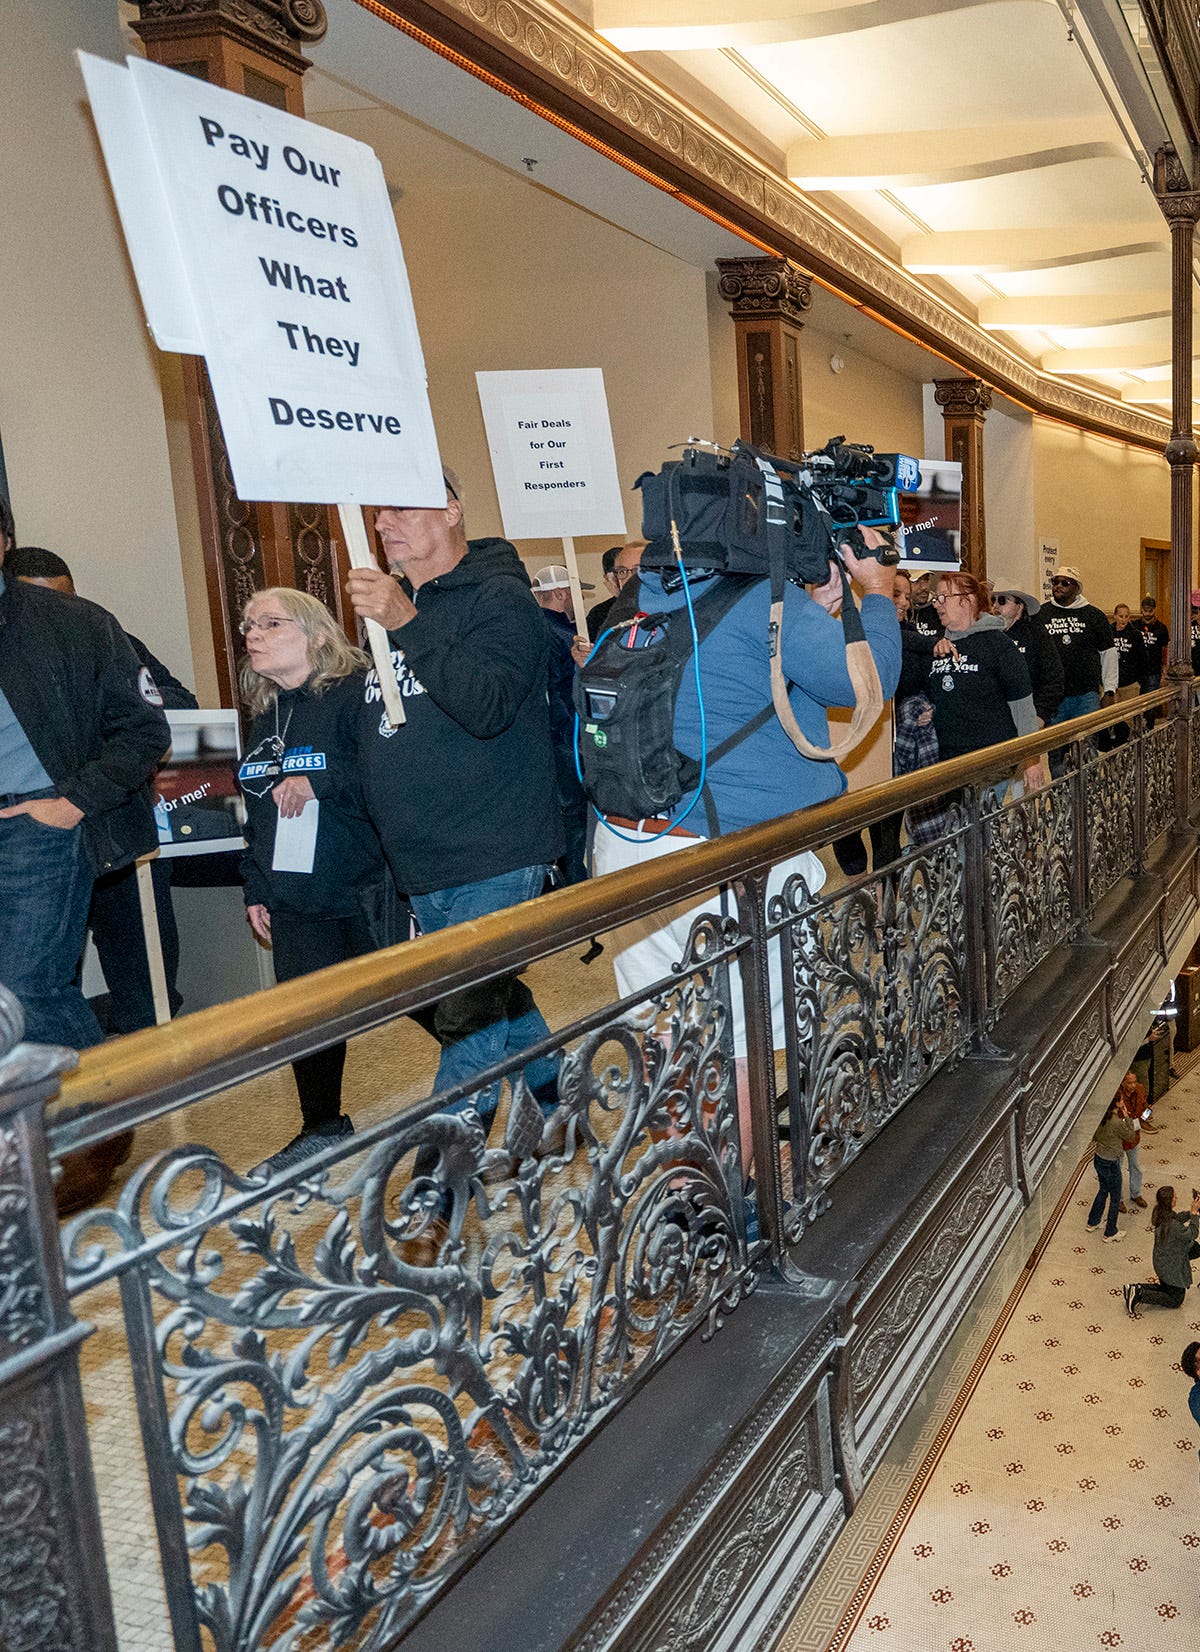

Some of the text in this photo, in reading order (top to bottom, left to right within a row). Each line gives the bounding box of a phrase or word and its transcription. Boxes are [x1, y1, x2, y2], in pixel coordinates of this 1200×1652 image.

[199, 116, 341, 188] Pay Our
[217, 183, 360, 249] Officers
[258, 257, 350, 303] What
[277, 320, 361, 367] They
[268, 397, 401, 435] Deserve
[518, 420, 571, 429] Fair Deals
[529, 440, 566, 449] for Our
[539, 461, 564, 469] First
[524, 480, 586, 490] Responders
[916, 516, 938, 532] me!"
[282, 756, 321, 769] EROES
[180, 782, 211, 805] me!"
